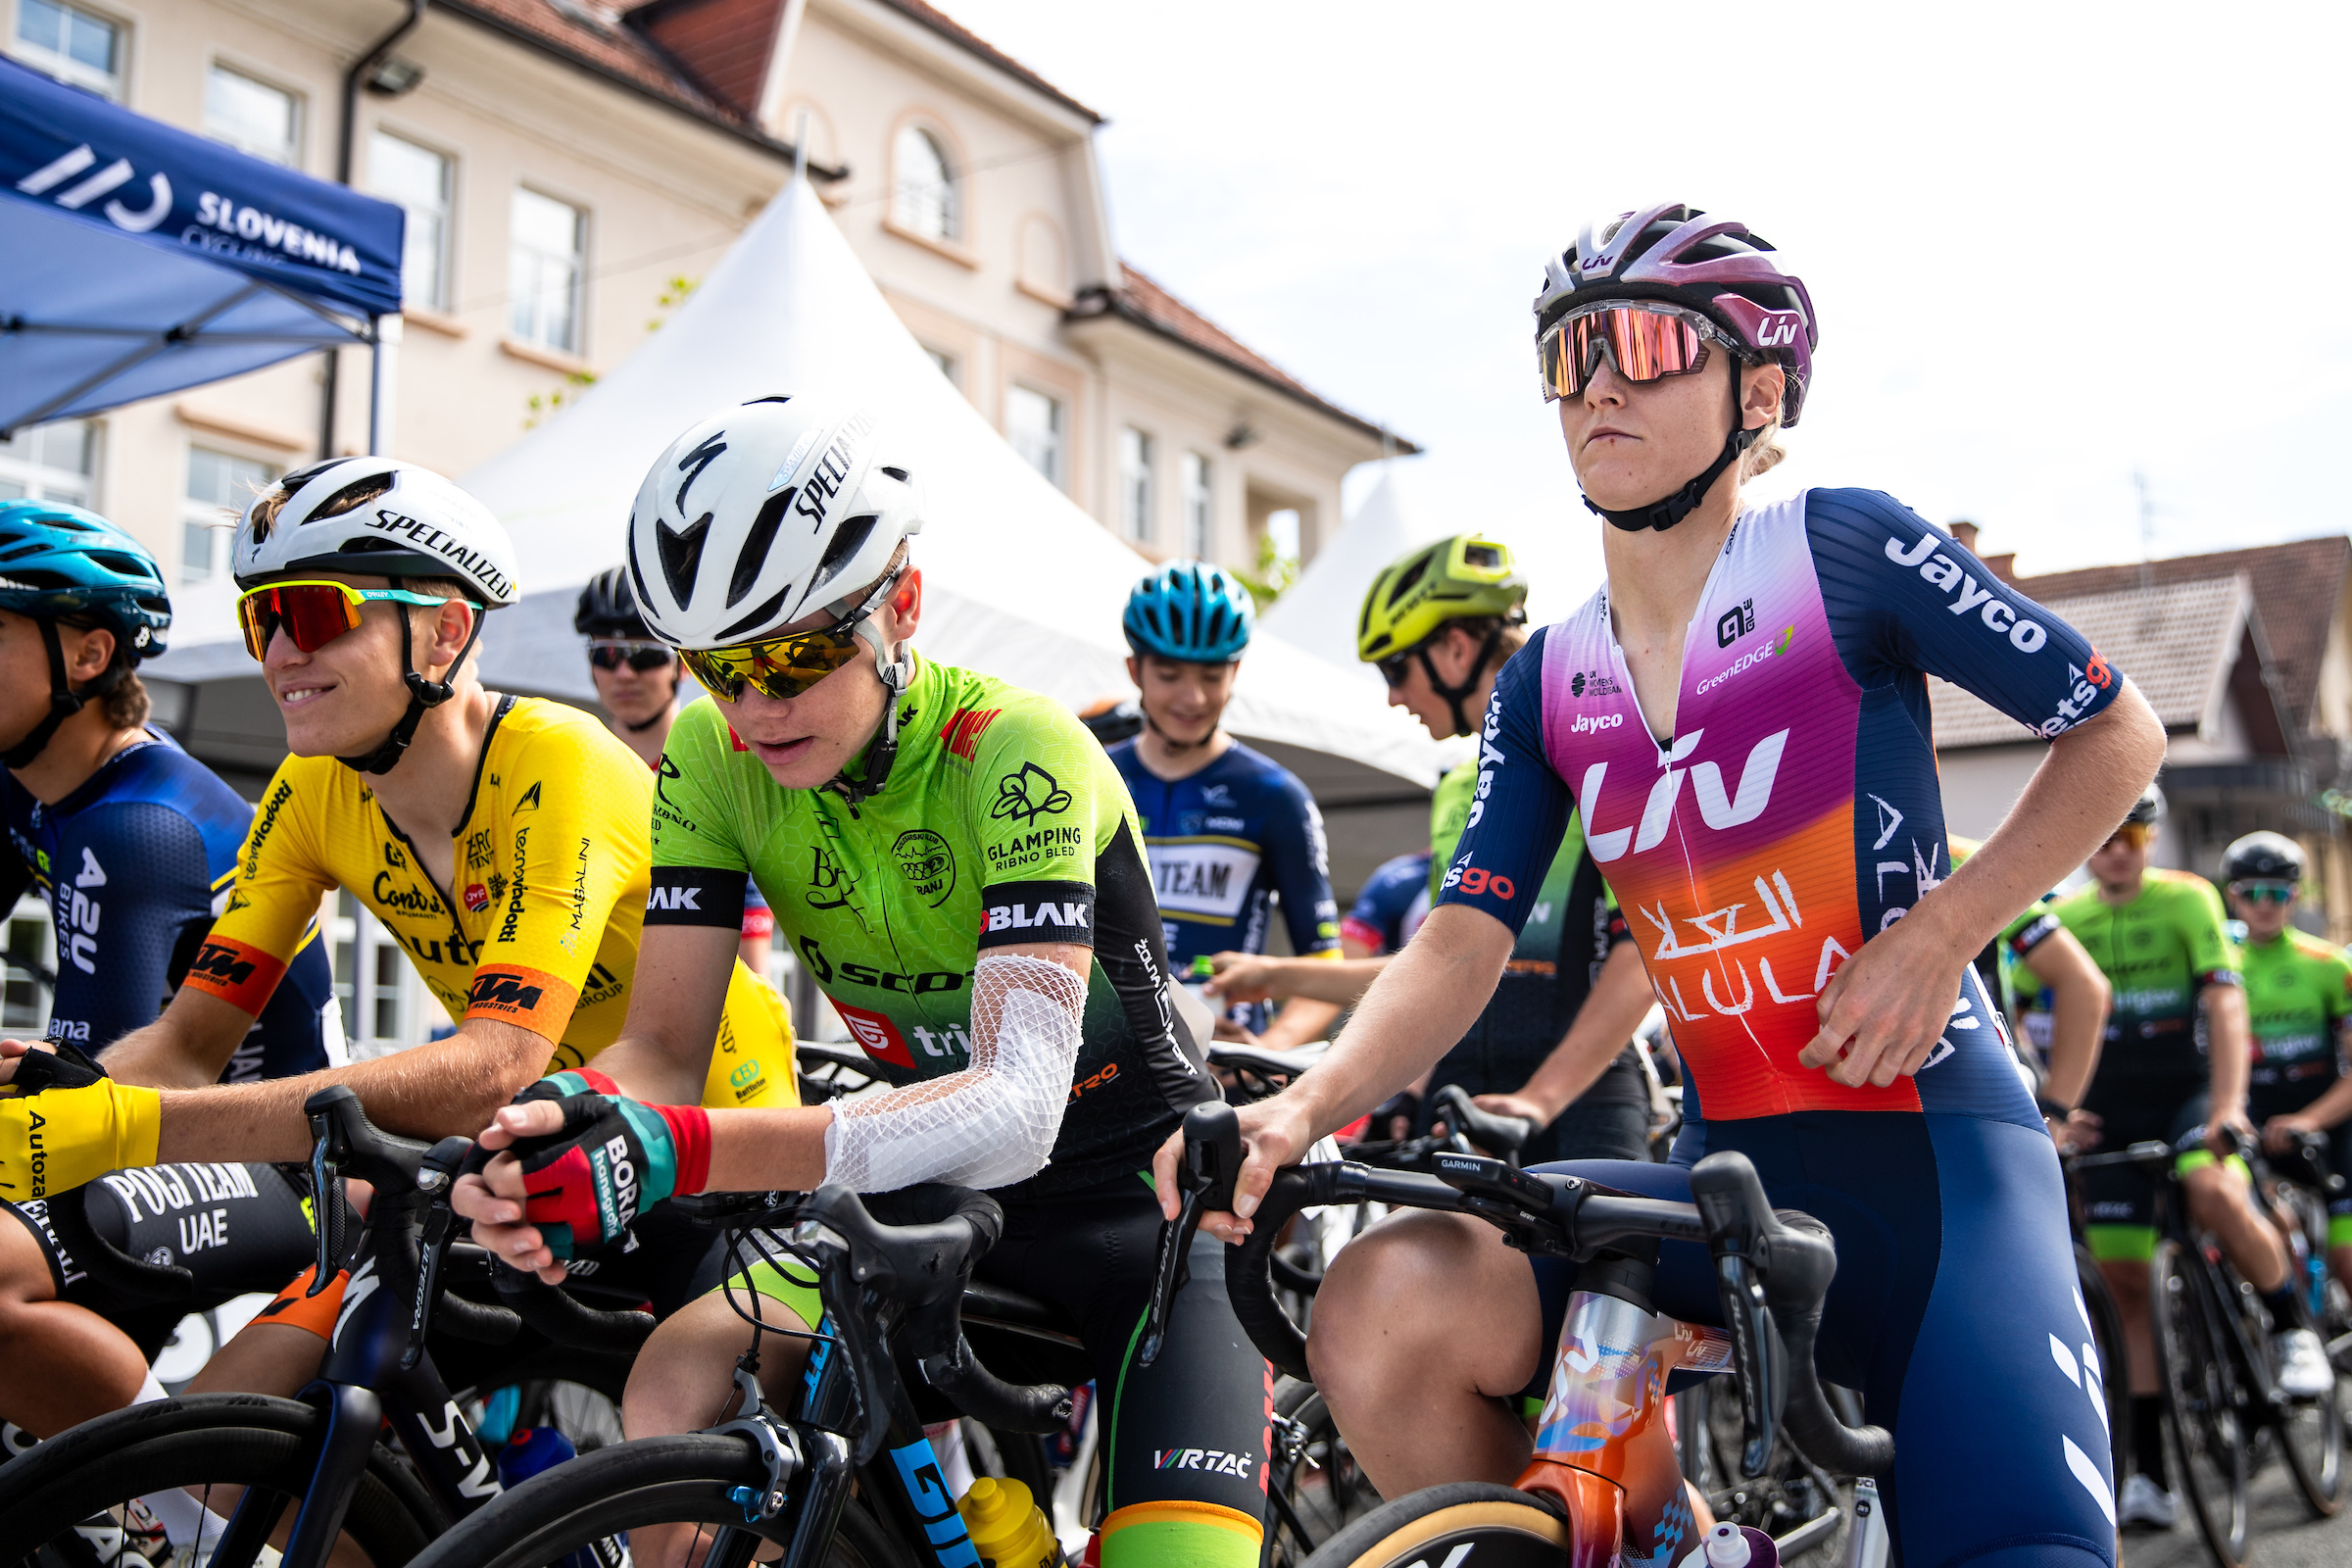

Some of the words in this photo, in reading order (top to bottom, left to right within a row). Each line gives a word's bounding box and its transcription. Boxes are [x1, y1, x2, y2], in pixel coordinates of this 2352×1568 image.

[196, 192, 362, 275] SLOVENIA
[1582, 255, 1613, 270] Liv
[1757, 317, 1797, 346] Liv
[365, 510, 513, 600] SPECIALIZED
[1884, 532, 2048, 654] Jayco
[1695, 640, 1774, 696] GreenEDGE
[1570, 712, 1624, 735] Jayco
[1579, 727, 1790, 863] Liv
[987, 827, 1082, 861] GLAMPING
[995, 850, 1040, 872] RIBNO
[1046, 845, 1075, 859] BLED
[569, 836, 591, 931] MAGALINI
[913, 878, 945, 896] RANJ
[1158, 859, 1234, 901] TEAM
[59, 881, 74, 961] BIKES
[70, 846, 108, 976] A2U
[838, 961, 975, 996] SCO
[471, 1002, 519, 1014] INDUSTRIES
[1068, 1062, 1118, 1102] TRO
[28, 1109, 48, 1202] Autoza
[606, 1134, 637, 1232] BORA
[1440, 1158, 1481, 1173] GARMIN
[103, 1162, 194, 1224] POGI
[185, 1162, 259, 1203] TEAM
[177, 1208, 229, 1255] UAE
[412, 1242, 431, 1330] ULTEGRA
[1152, 1219, 1176, 1324] DURA-ACE
[1730, 1293, 1757, 1426] DURA-ACE
[1153, 1448, 1253, 1480] VRTAČ
